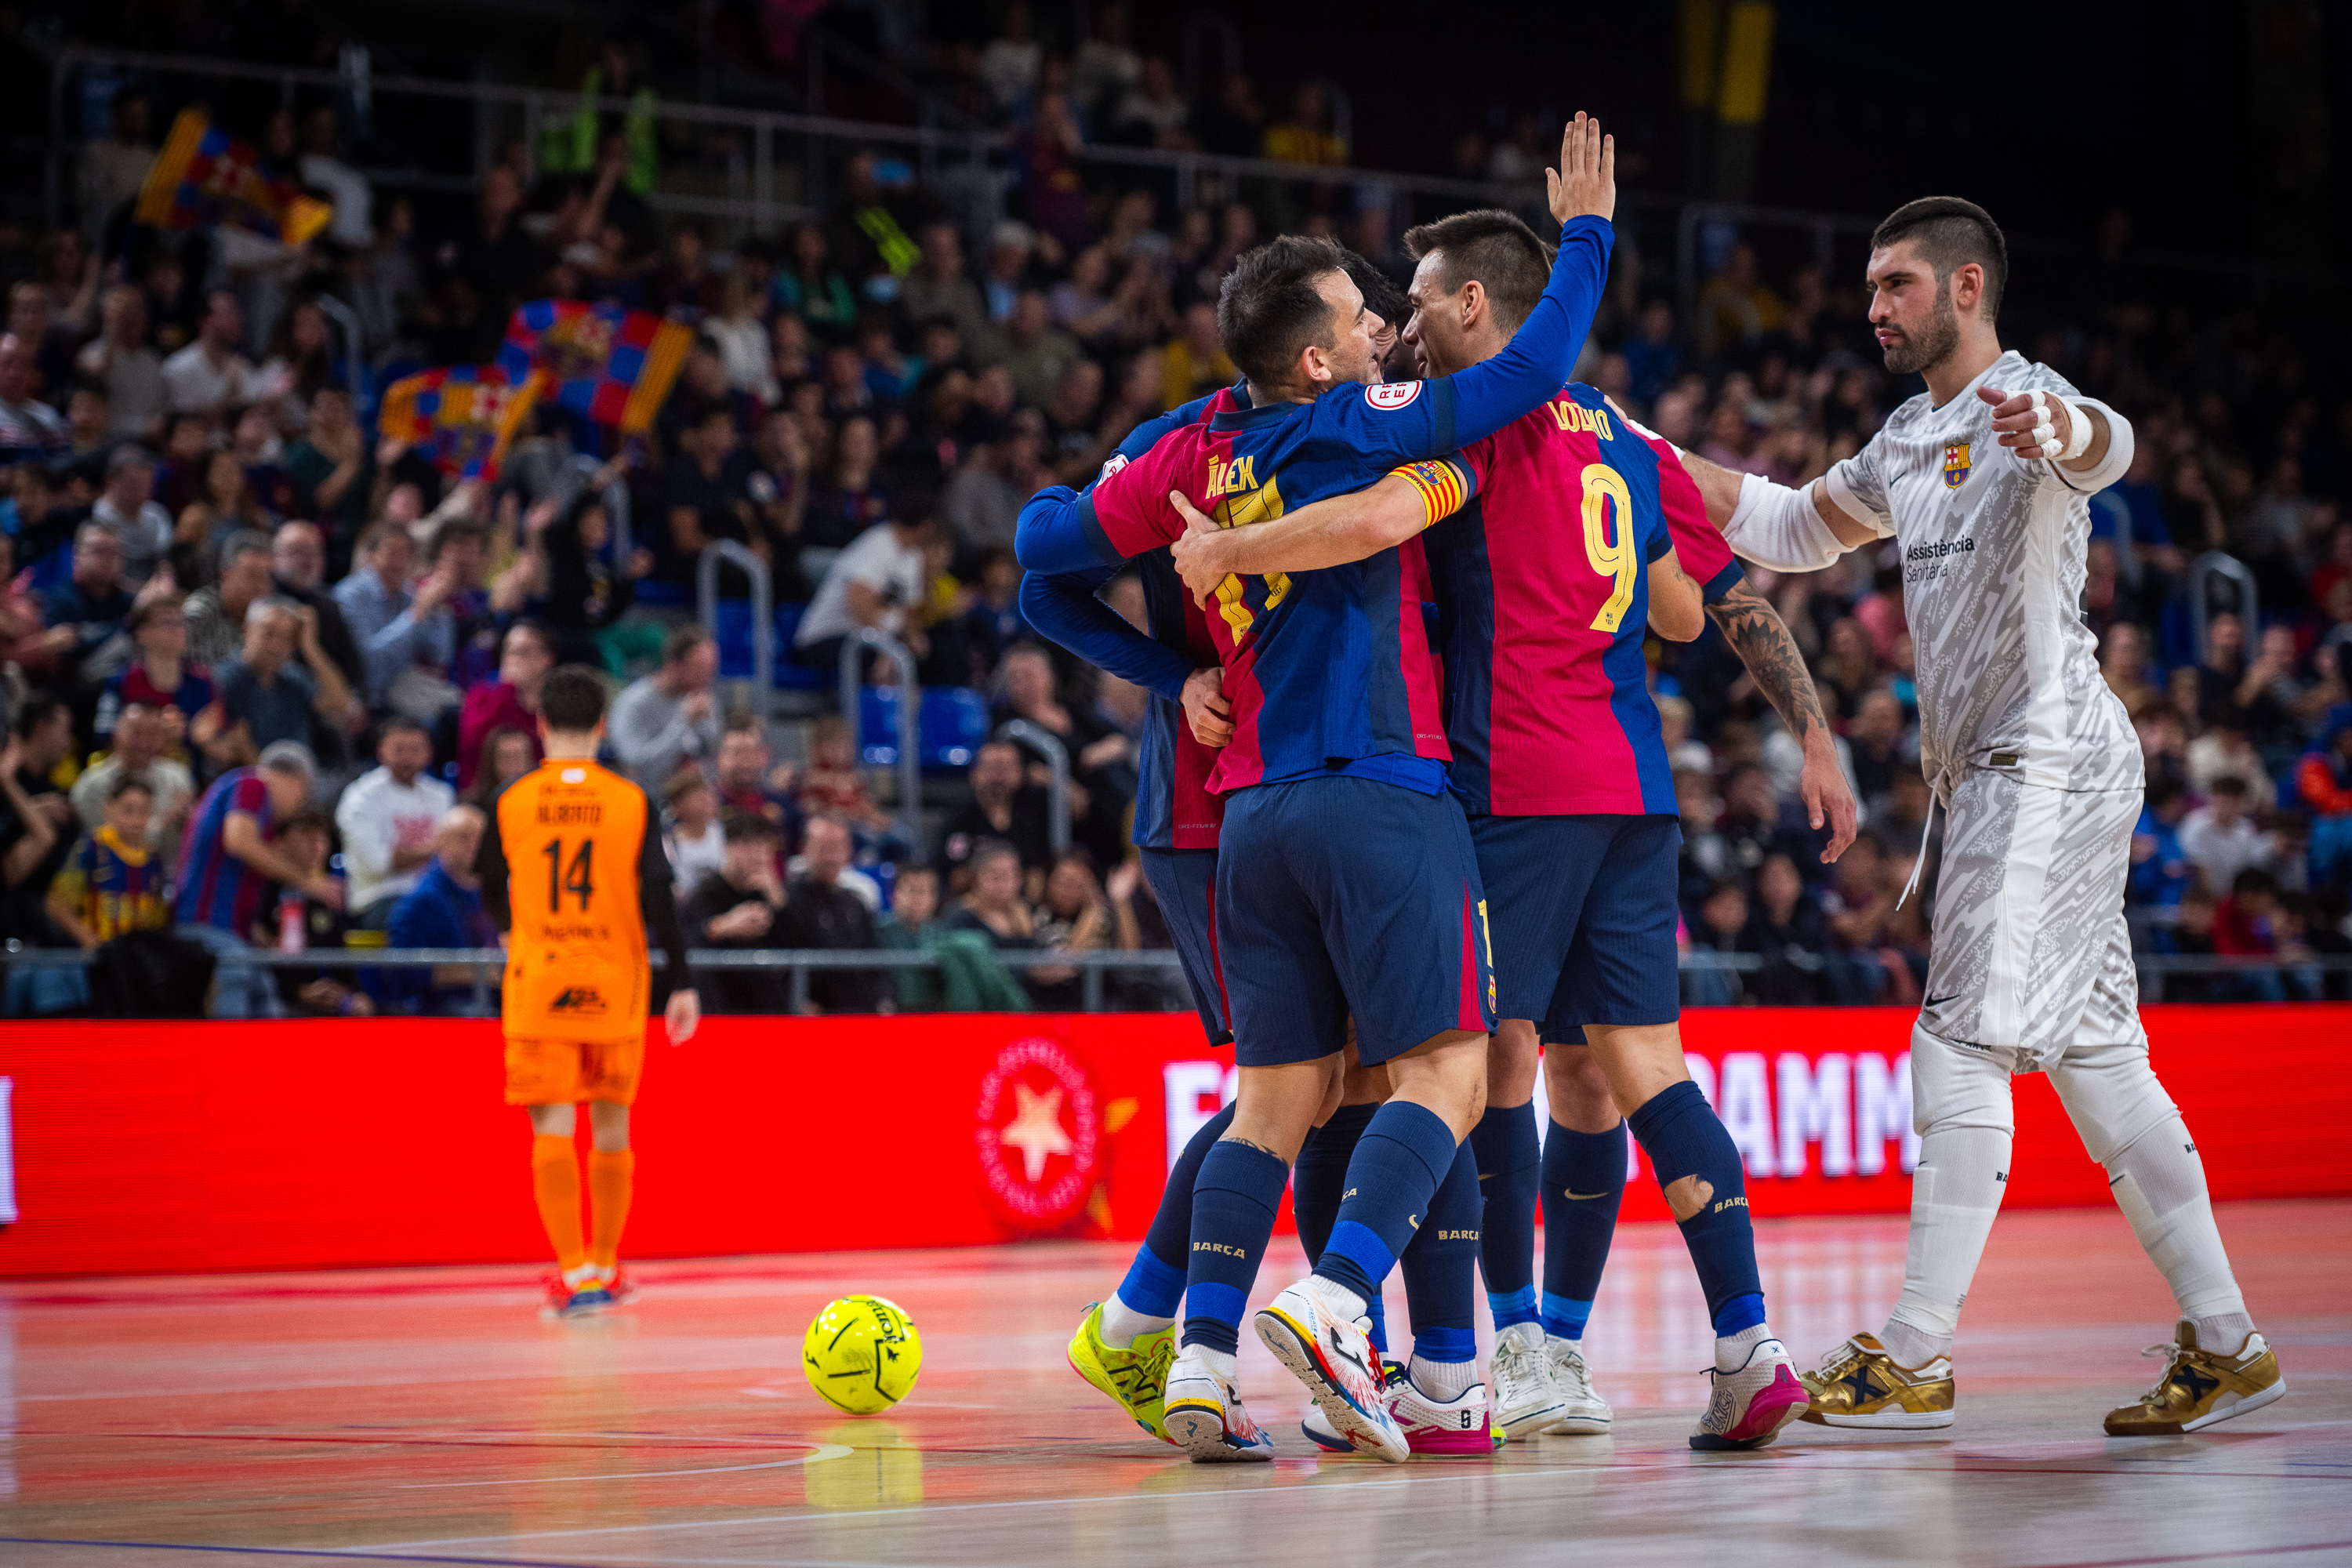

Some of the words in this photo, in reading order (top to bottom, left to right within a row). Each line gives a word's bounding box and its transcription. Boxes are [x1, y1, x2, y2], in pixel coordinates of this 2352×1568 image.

[1205, 455, 1259, 499] ÁLEX
[1581, 463, 1637, 633] 9
[1907, 535, 1975, 562] Assistència
[1907, 560, 1948, 583] Sanitària
[541, 838, 594, 913] 14
[1438, 1230, 1479, 1241] BARÇA
[1192, 1242, 1245, 1259] BARÇA
